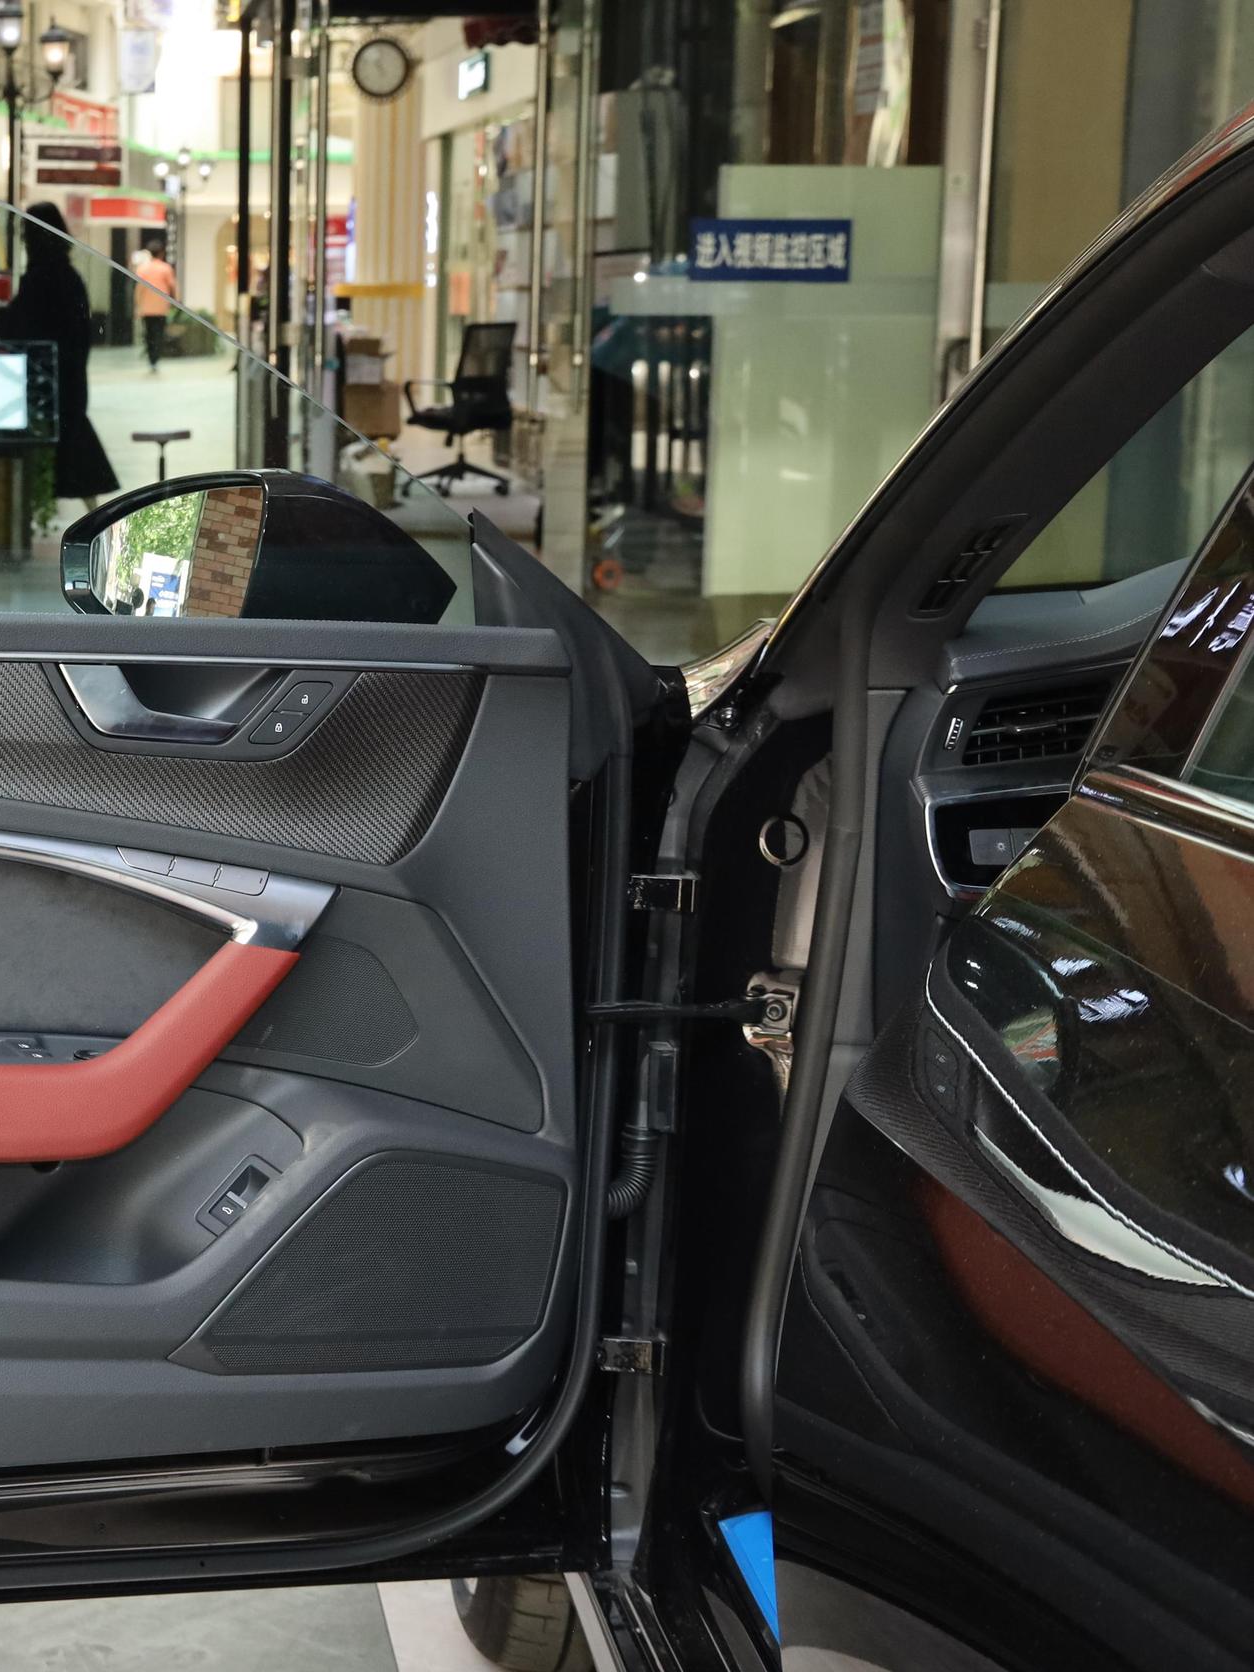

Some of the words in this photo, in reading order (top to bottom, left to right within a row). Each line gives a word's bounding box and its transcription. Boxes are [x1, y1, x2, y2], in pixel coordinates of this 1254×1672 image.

[696, 231, 846, 269] 进入视频监控区域
